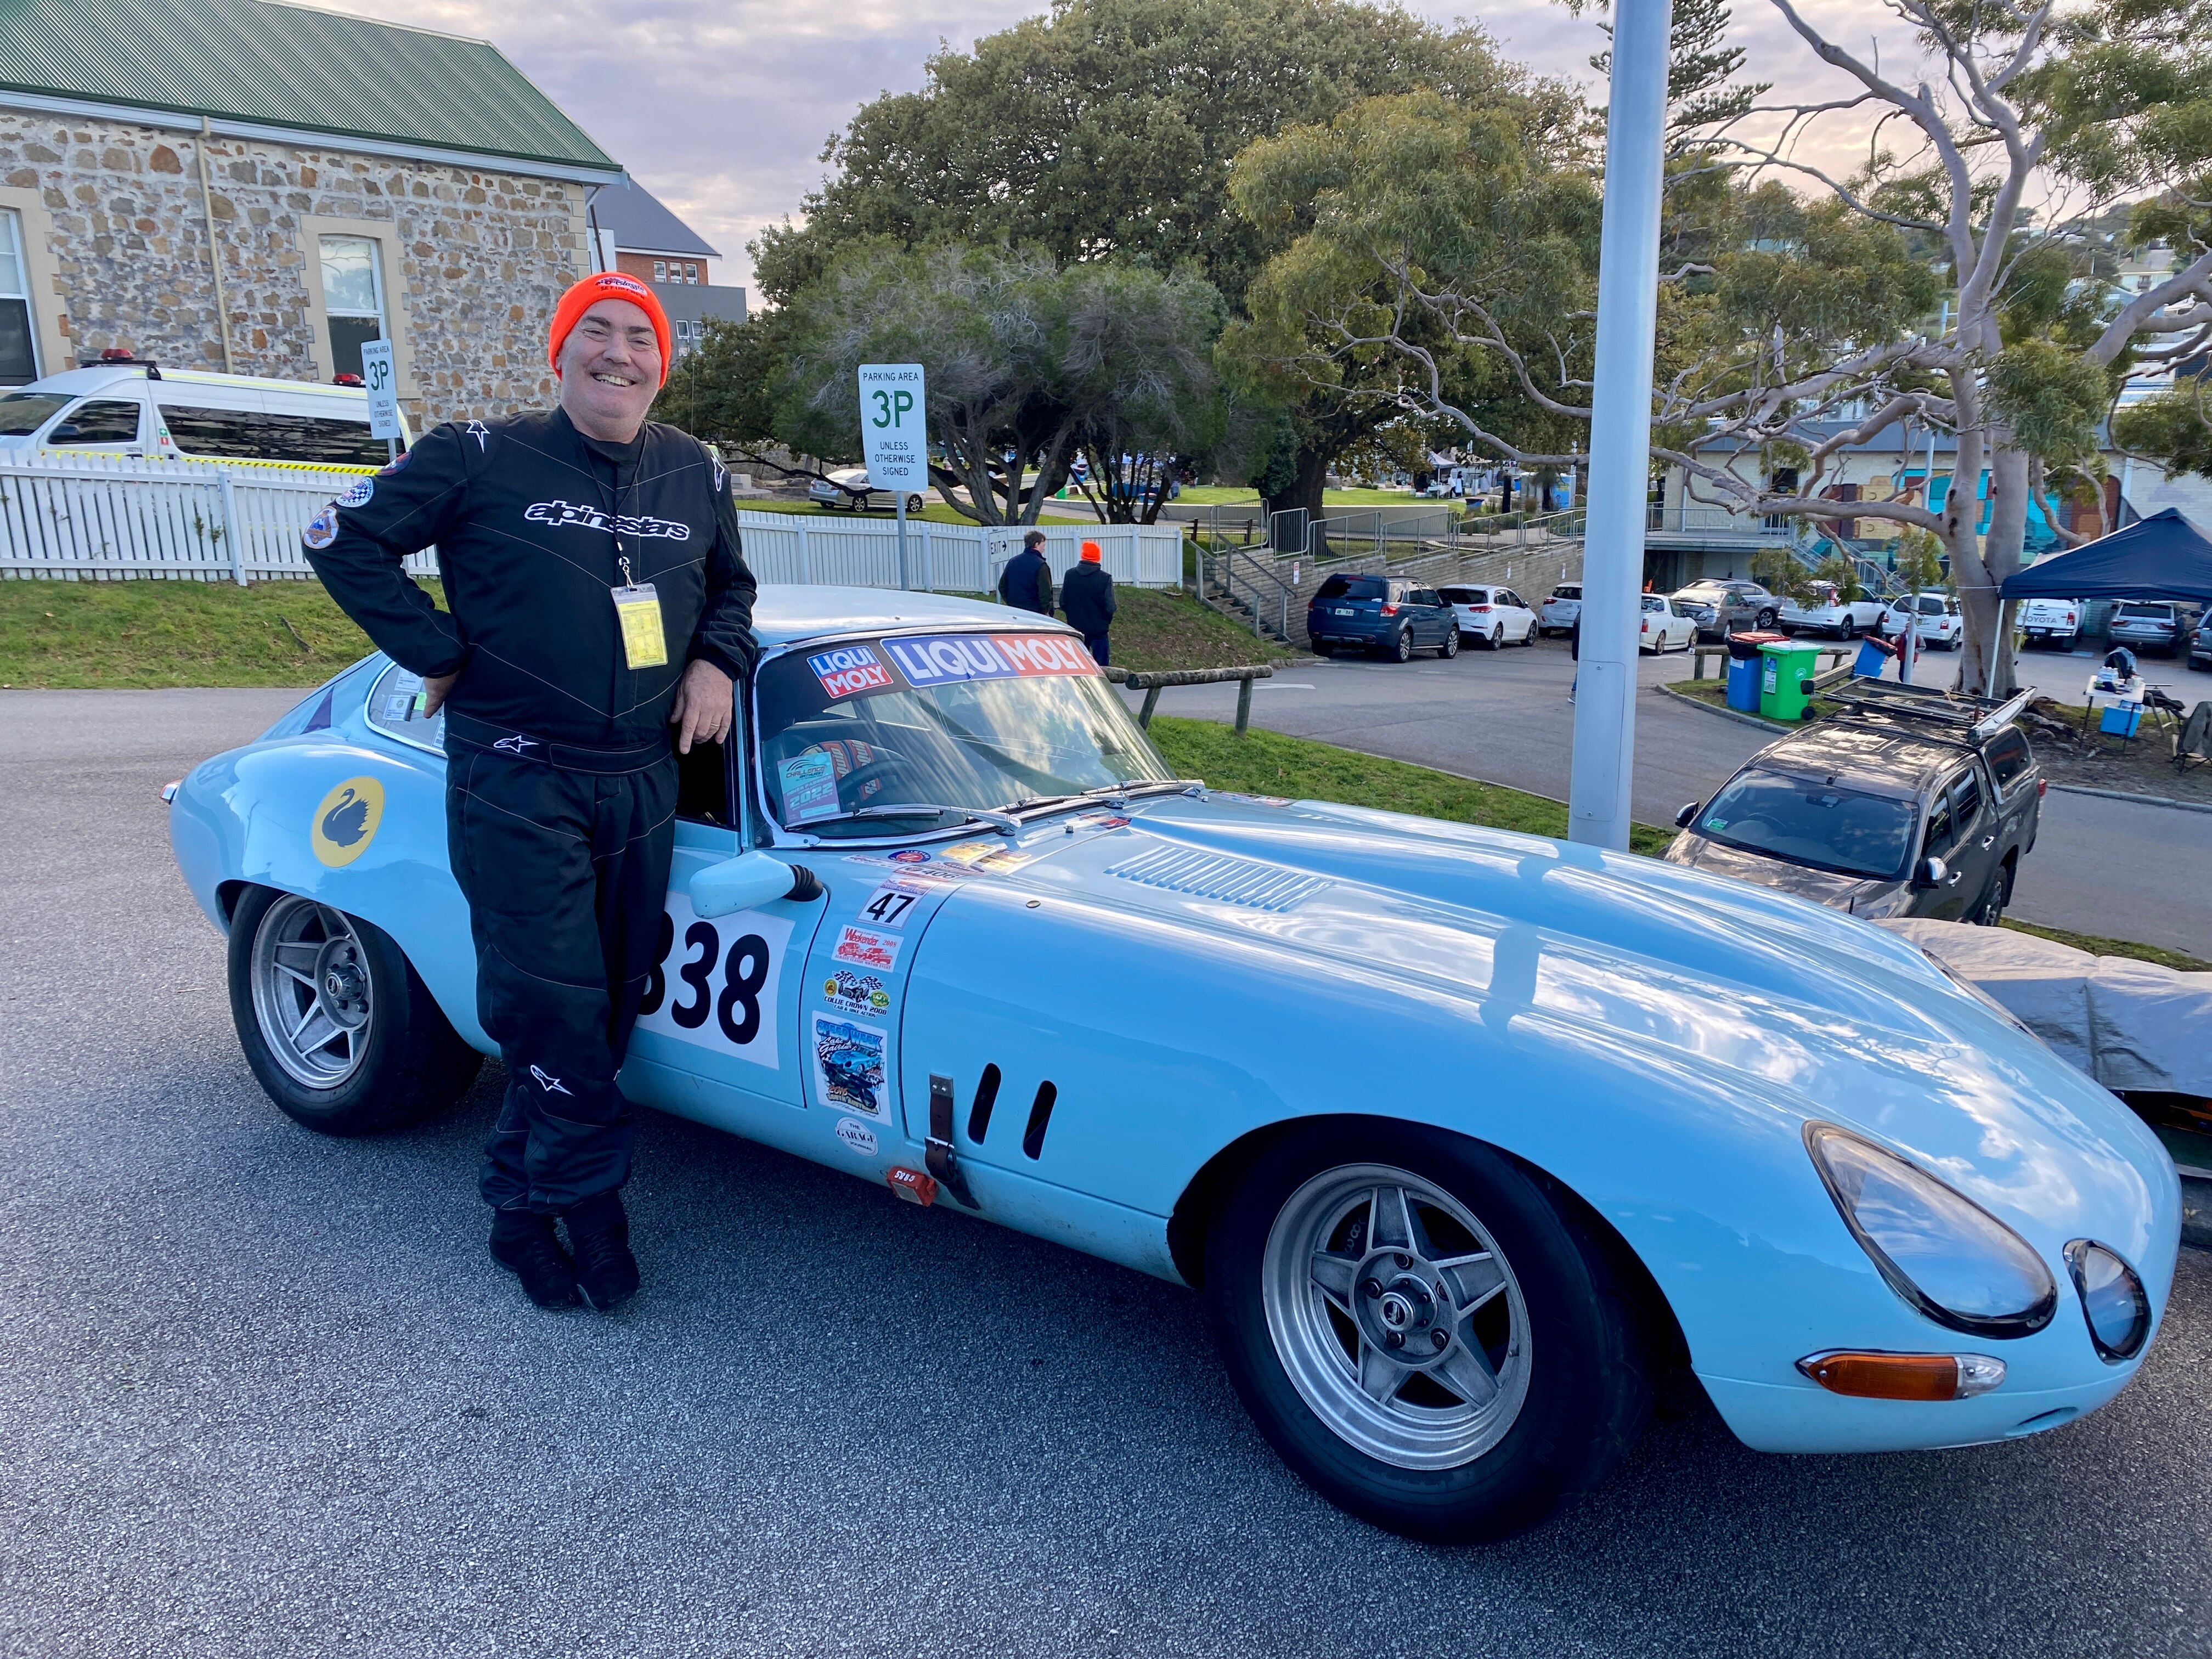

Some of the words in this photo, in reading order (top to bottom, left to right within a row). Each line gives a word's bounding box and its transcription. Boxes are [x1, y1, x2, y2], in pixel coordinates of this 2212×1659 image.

[363, 347, 379, 356] PARKING
[369, 360, 388, 391] 3P
[863, 373, 895, 381] PARKING
[898, 372, 919, 381] AREA
[374, 409, 393, 418] OTHERWISE
[872, 390, 913, 428] 3P
[880, 441, 909, 450] UNLESS
[874, 454, 916, 464] OTHERWISE
[882, 467, 909, 476] SIGNED
[990, 541, 1001, 555] EXIT
[812, 648, 876, 675] LIQUI
[891, 640, 1011, 679] LIQUI
[997, 639, 1086, 670] MOLY
[825, 666, 886, 695] MOLY
[786, 766, 826, 778] CHALLENGE
[790, 782, 833, 809] 2022
[866, 893, 916, 923] 47
[844, 928, 879, 946] Weekender
[882, 939, 898, 947] 2008
[823, 996, 844, 1005] COLLIE
[845, 1001, 868, 1011] CROWN
[870, 1006, 887, 1015] 2008
[817, 1019, 850, 1041] SPEED
[850, 1030, 883, 1053] WEEK
